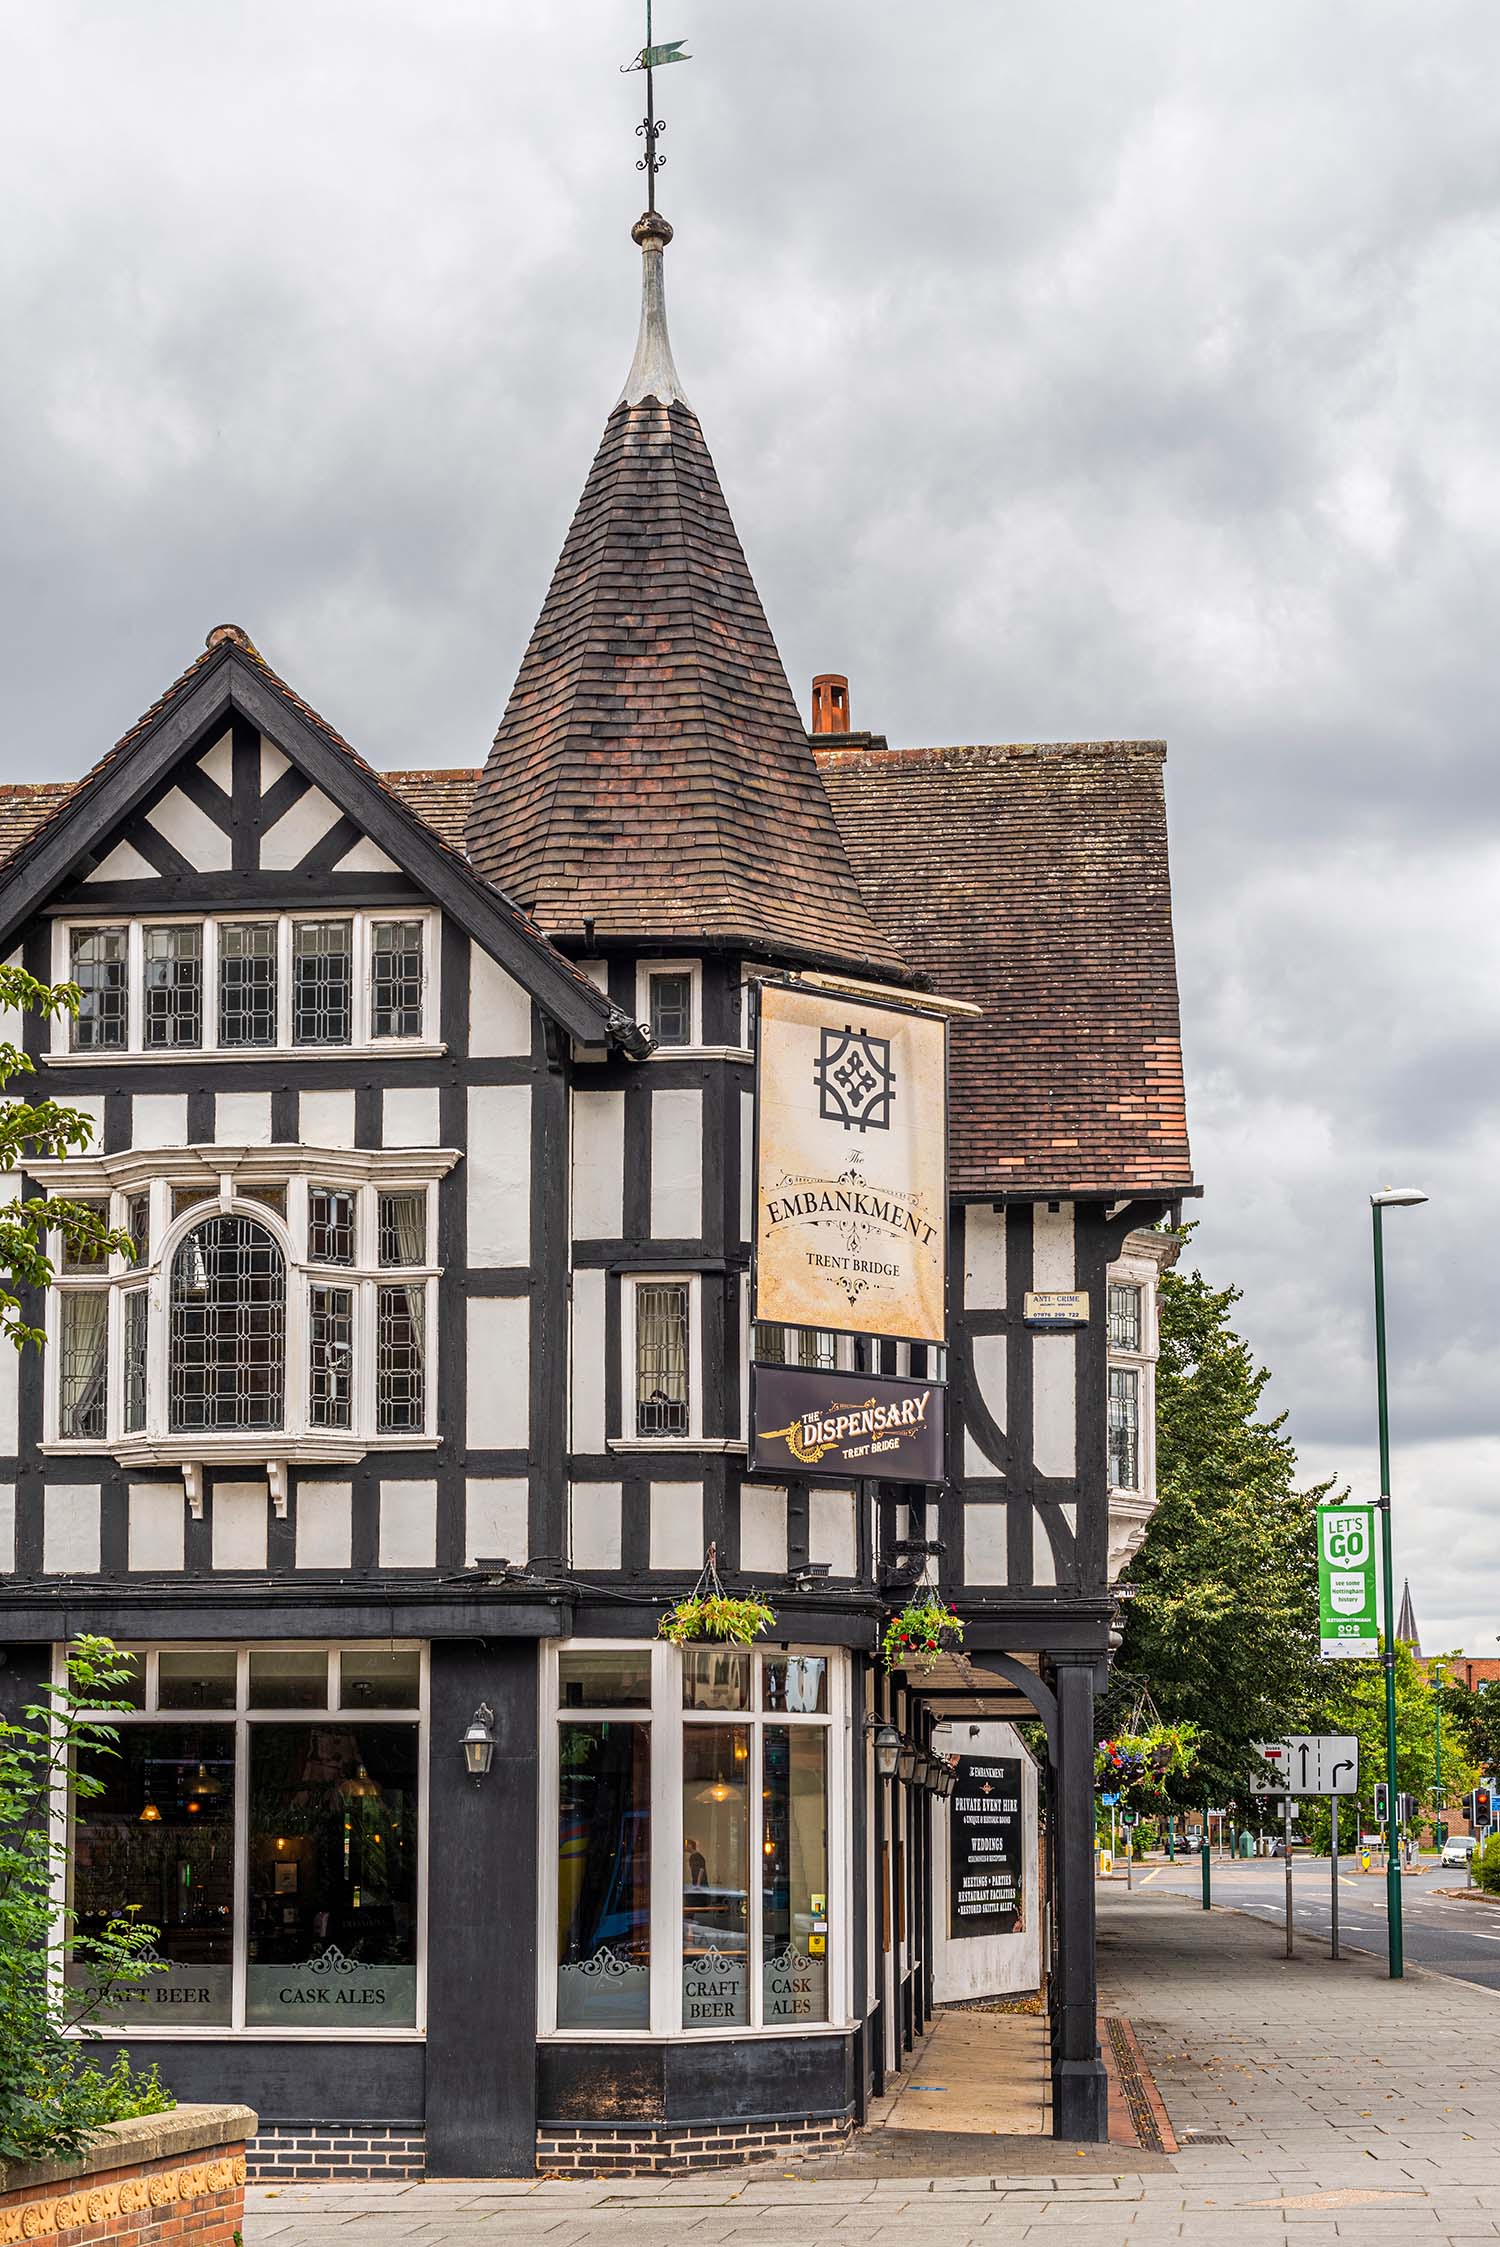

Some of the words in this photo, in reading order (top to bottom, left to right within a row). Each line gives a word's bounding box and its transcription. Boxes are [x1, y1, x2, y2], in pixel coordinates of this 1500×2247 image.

[845, 1149, 864, 1164] The
[766, 1190, 937, 1246] EMBANKMENT
[806, 1252, 850, 1270] TRENT
[853, 1259, 900, 1277] BRIDGE
[801, 1411, 820, 1424] THE
[803, 1390, 931, 1447] DISPENSARY
[842, 1445, 870, 1460] TRENT
[871, 1437, 900, 1453] BRIDGE
[1329, 1517, 1363, 1534] LET'S
[1330, 1532, 1363, 1558] GO
[975, 1767, 1004, 1778] EMBANKMENT
[955, 1797, 981, 1811] PRIVATE
[982, 1798, 1001, 1812] EVENT
[1003, 1799, 1018, 1812] HIRE
[971, 1837, 1003, 1851] WEDDINGS
[963, 1876, 988, 1888] MEETINGS
[992, 1875, 1011, 1886] PARTIES
[958, 1889, 989, 1903] RESTAURANT
[990, 1888, 1016, 1900] FACILITIES
[960, 1904, 981, 1915] RESTORED
[1000, 1902, 1013, 1912] ALLEY
[686, 1980, 740, 1998] CRAFT
[772, 1978, 811, 1995] CASK
[157, 1987, 211, 2004] BEER
[279, 1988, 329, 2005] CASK
[335, 1988, 386, 2005] ALES
[690, 2002, 736, 2019] BEER
[772, 1999, 811, 2016] ALES
